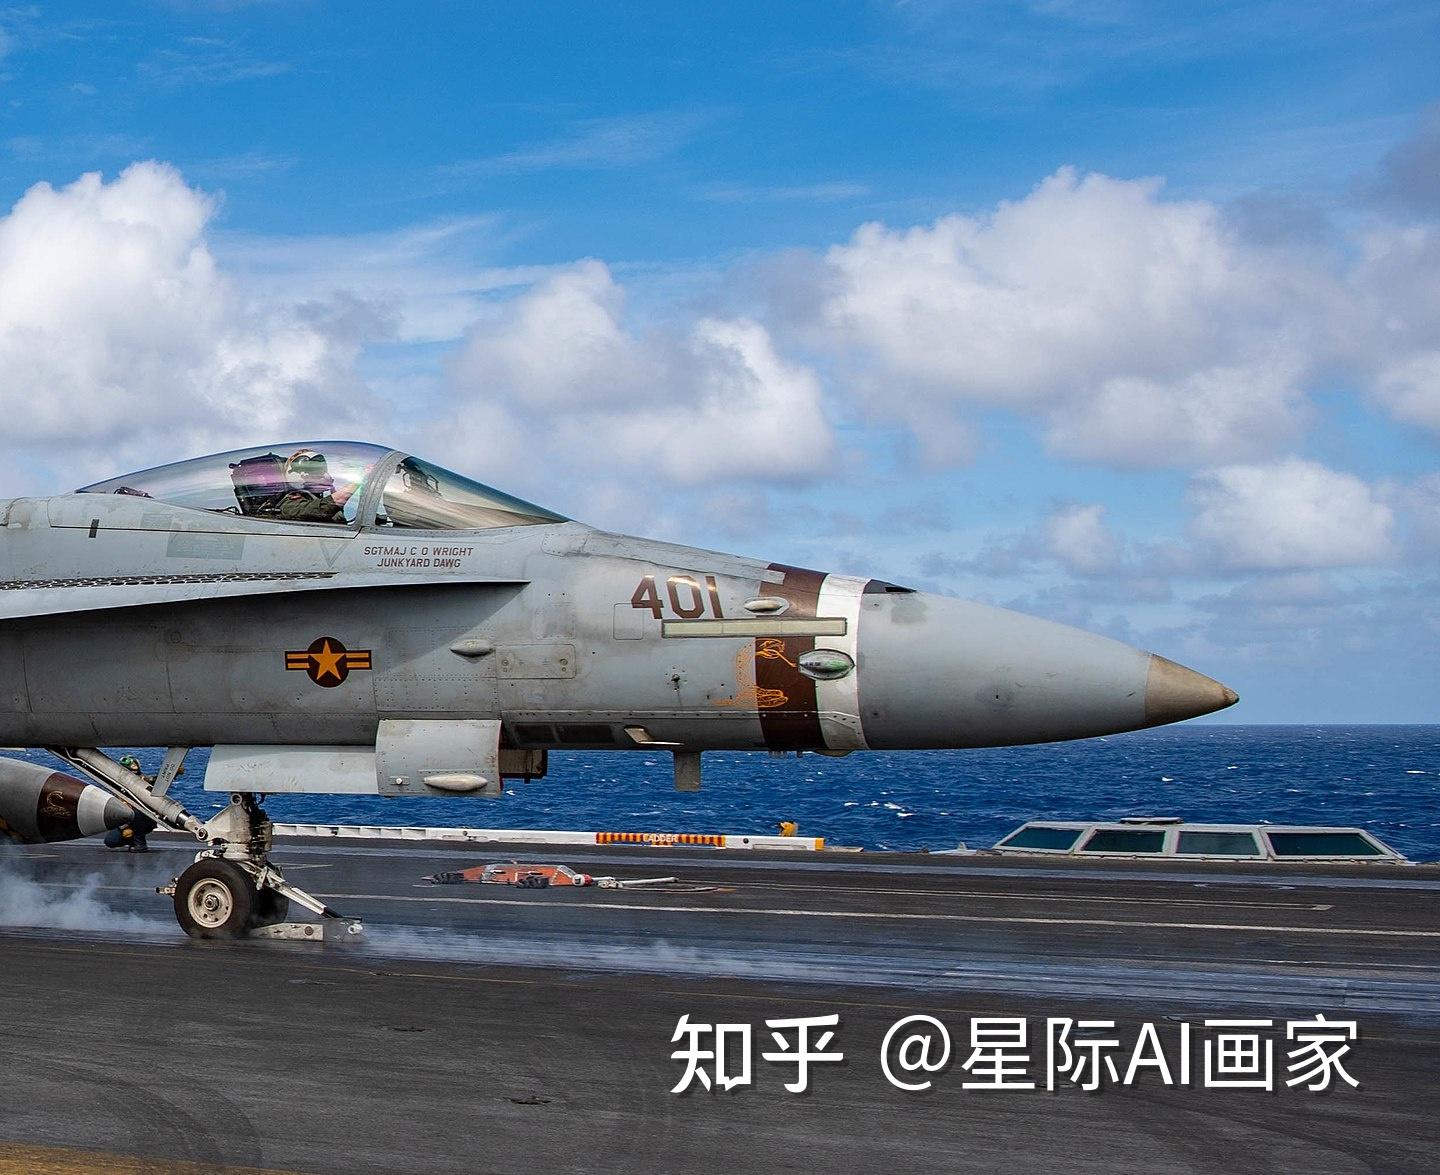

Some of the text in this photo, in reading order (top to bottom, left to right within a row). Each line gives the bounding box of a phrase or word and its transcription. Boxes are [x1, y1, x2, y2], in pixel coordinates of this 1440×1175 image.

[363, 546, 407, 556] SGTMAJ
[410, 547, 418, 556] C
[432, 547, 474, 557] WRIGHT
[377, 558, 461, 568] JUNKYARD DAWG
[631, 575, 724, 619] 401
[643, 833, 679, 843] LADDER
